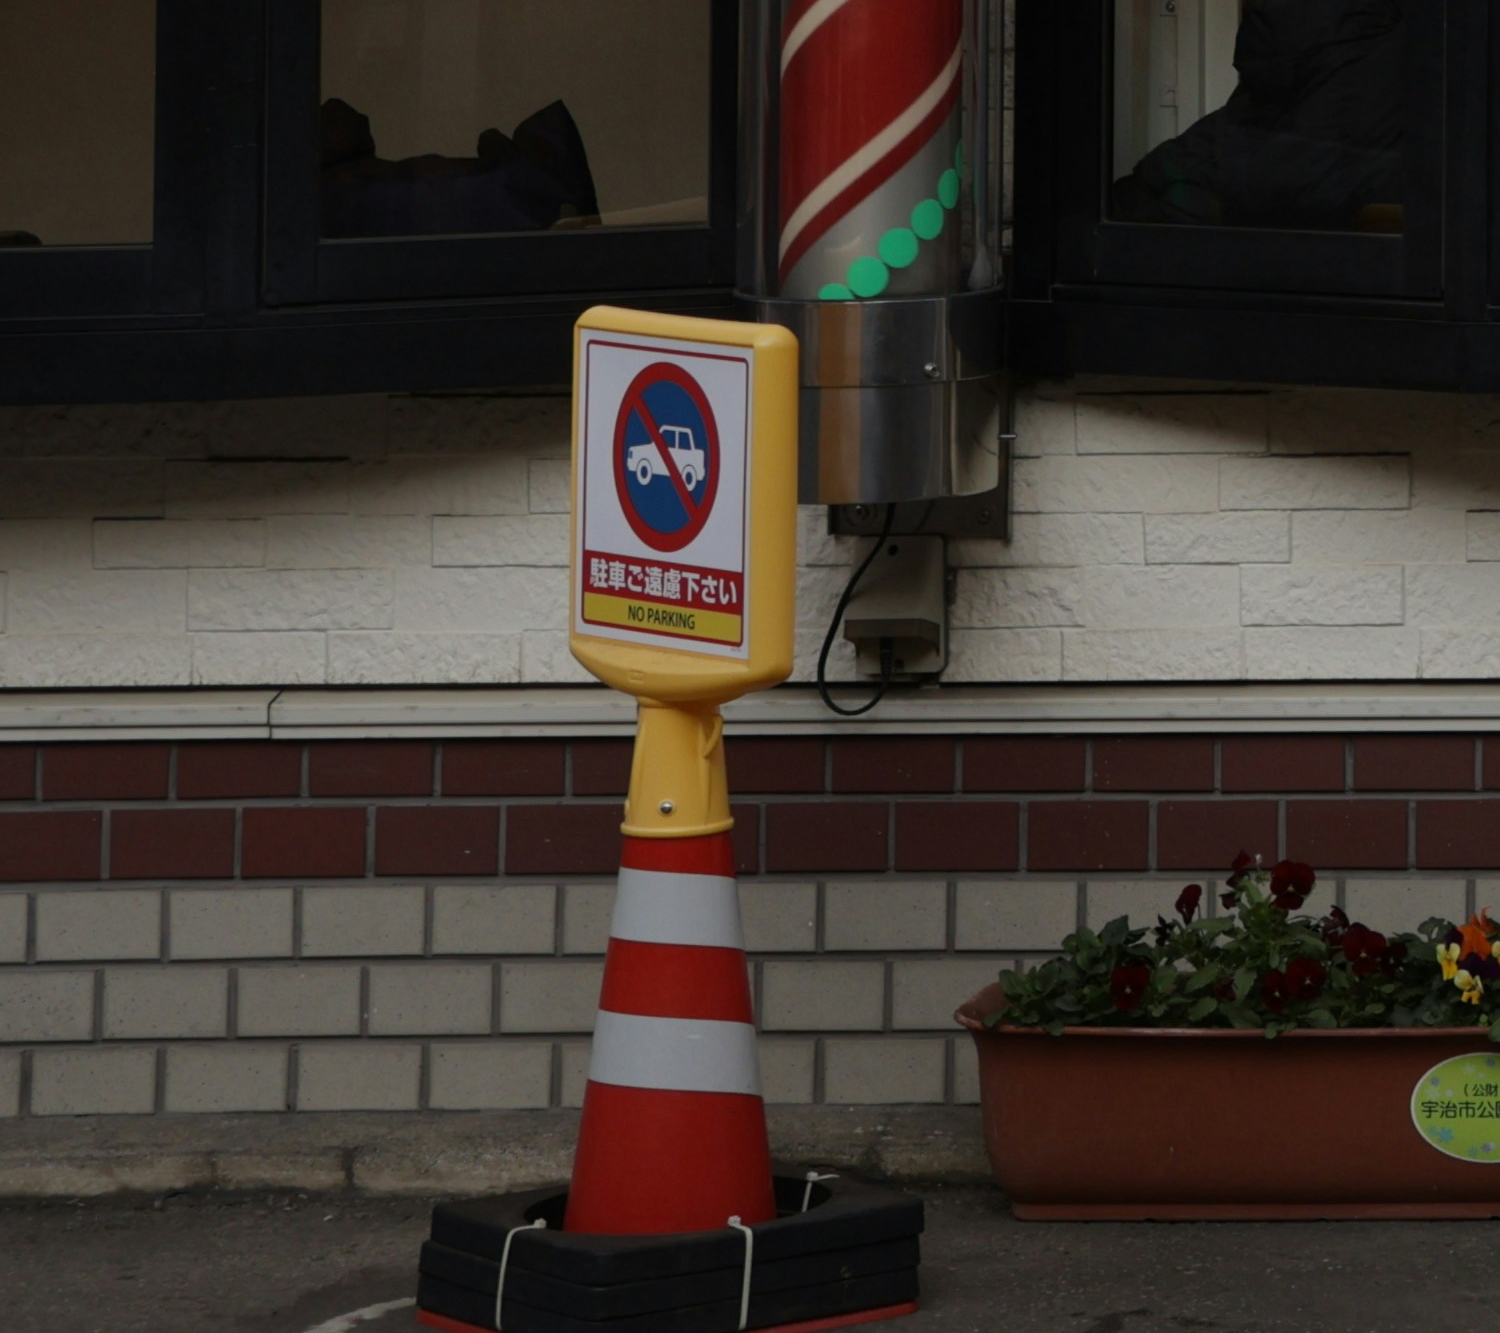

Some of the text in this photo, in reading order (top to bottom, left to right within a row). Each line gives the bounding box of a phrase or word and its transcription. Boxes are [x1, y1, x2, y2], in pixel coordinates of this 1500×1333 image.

[588, 556, 738, 607] 駐車ご遠慮下さい
[627, 604, 696, 631] NO PARKING
